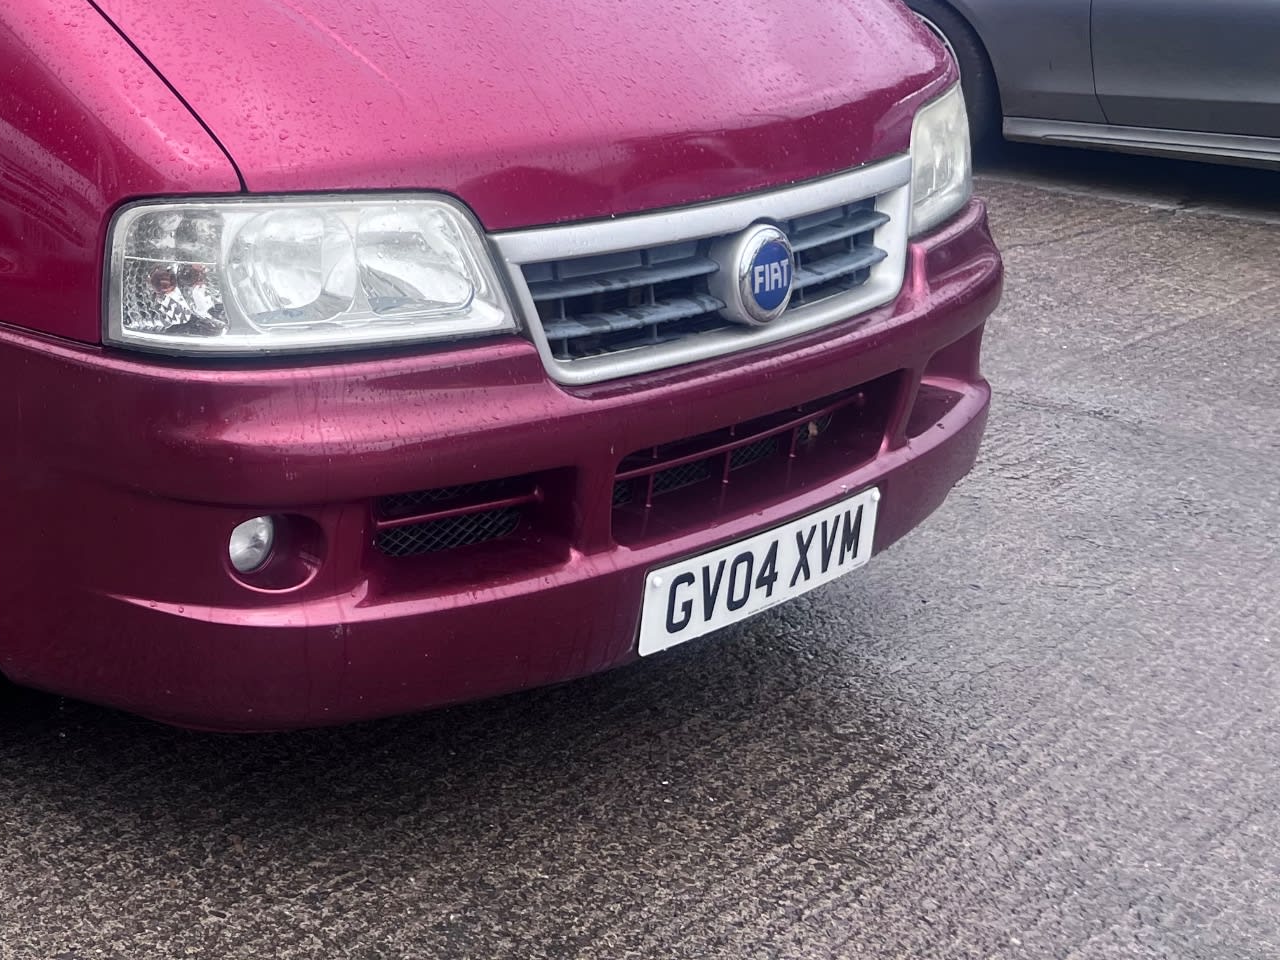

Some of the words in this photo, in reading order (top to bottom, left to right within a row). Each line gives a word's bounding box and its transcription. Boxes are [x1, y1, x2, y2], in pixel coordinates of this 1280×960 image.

[753, 258, 789, 294] FIAT
[665, 539, 779, 634] GV04
[789, 503, 864, 588] XVM
